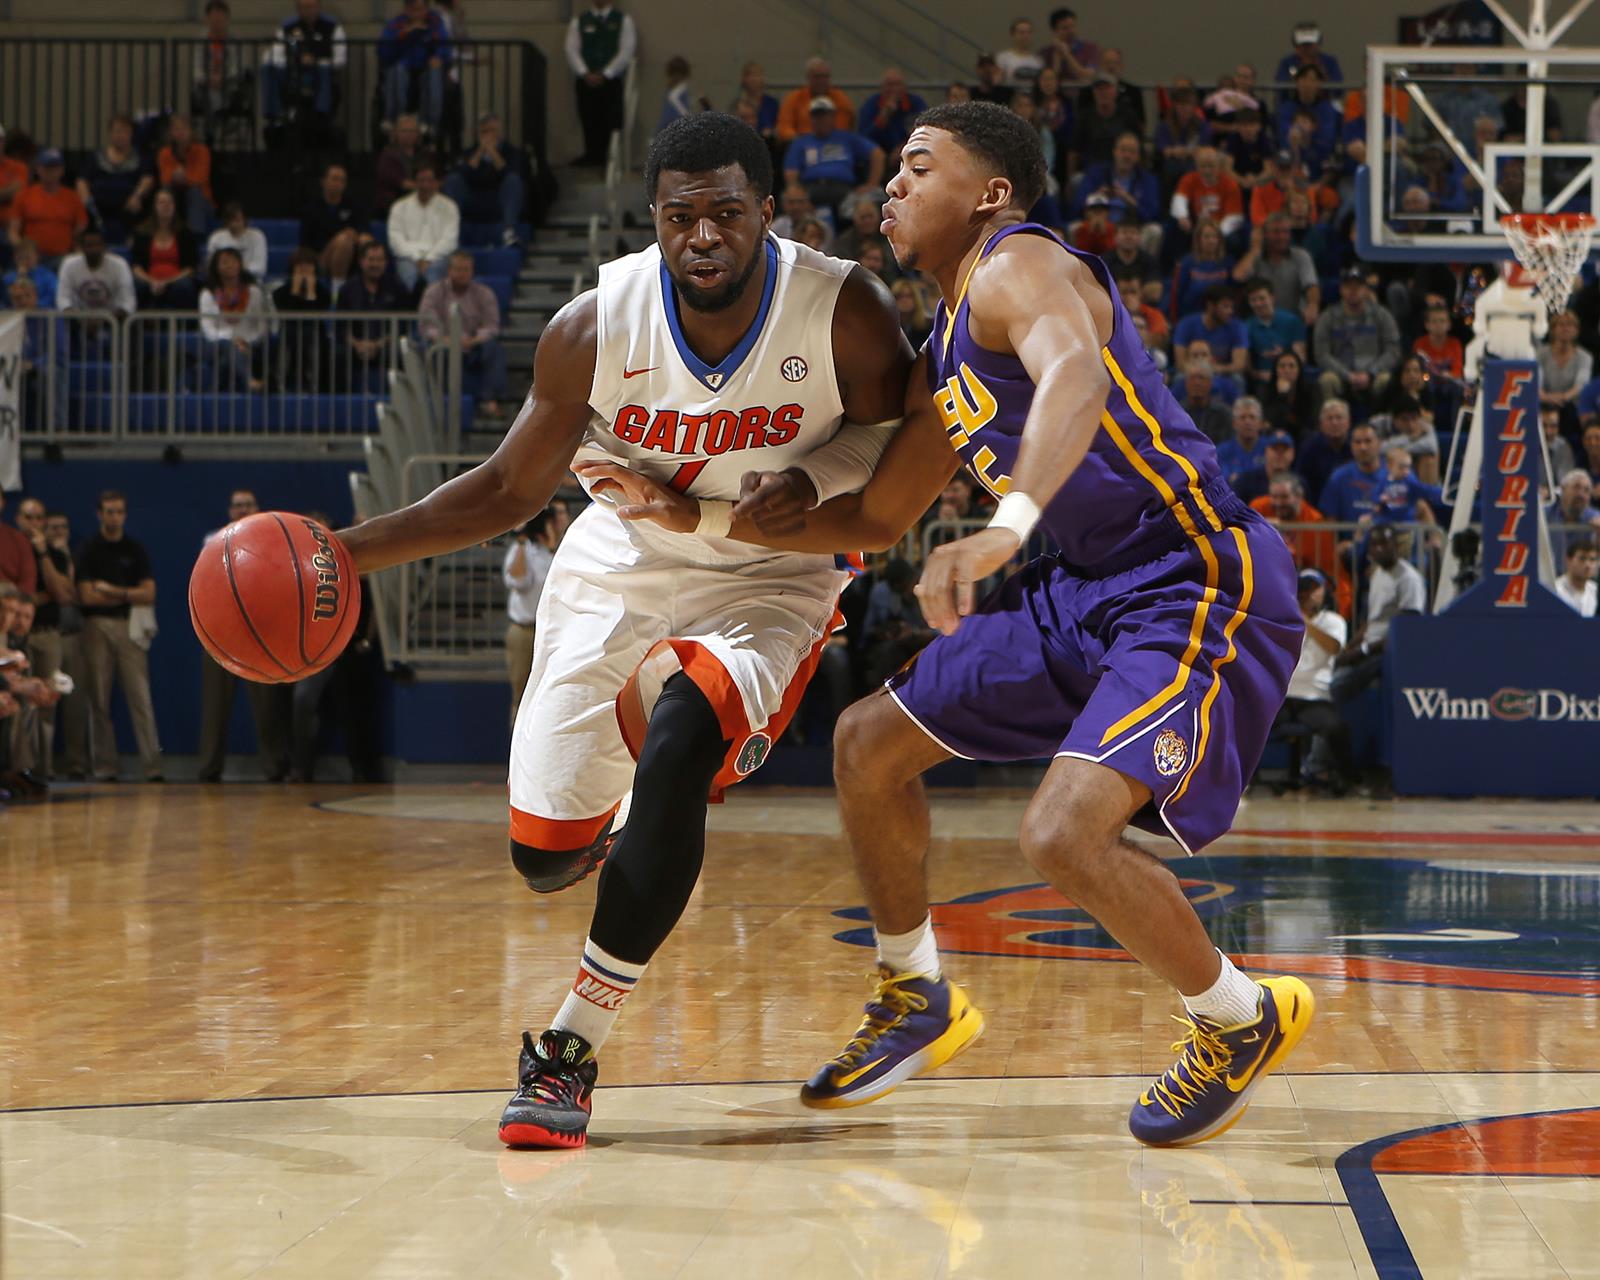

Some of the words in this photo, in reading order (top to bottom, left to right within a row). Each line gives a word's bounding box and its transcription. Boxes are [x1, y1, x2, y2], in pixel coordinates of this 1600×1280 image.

[781, 356, 808, 382] SEC
[612, 403, 805, 456] GATORS
[1491, 369, 1534, 607] FLORIDA
[301, 519, 341, 622] Wilson
[1401, 687, 1491, 721] Winn
